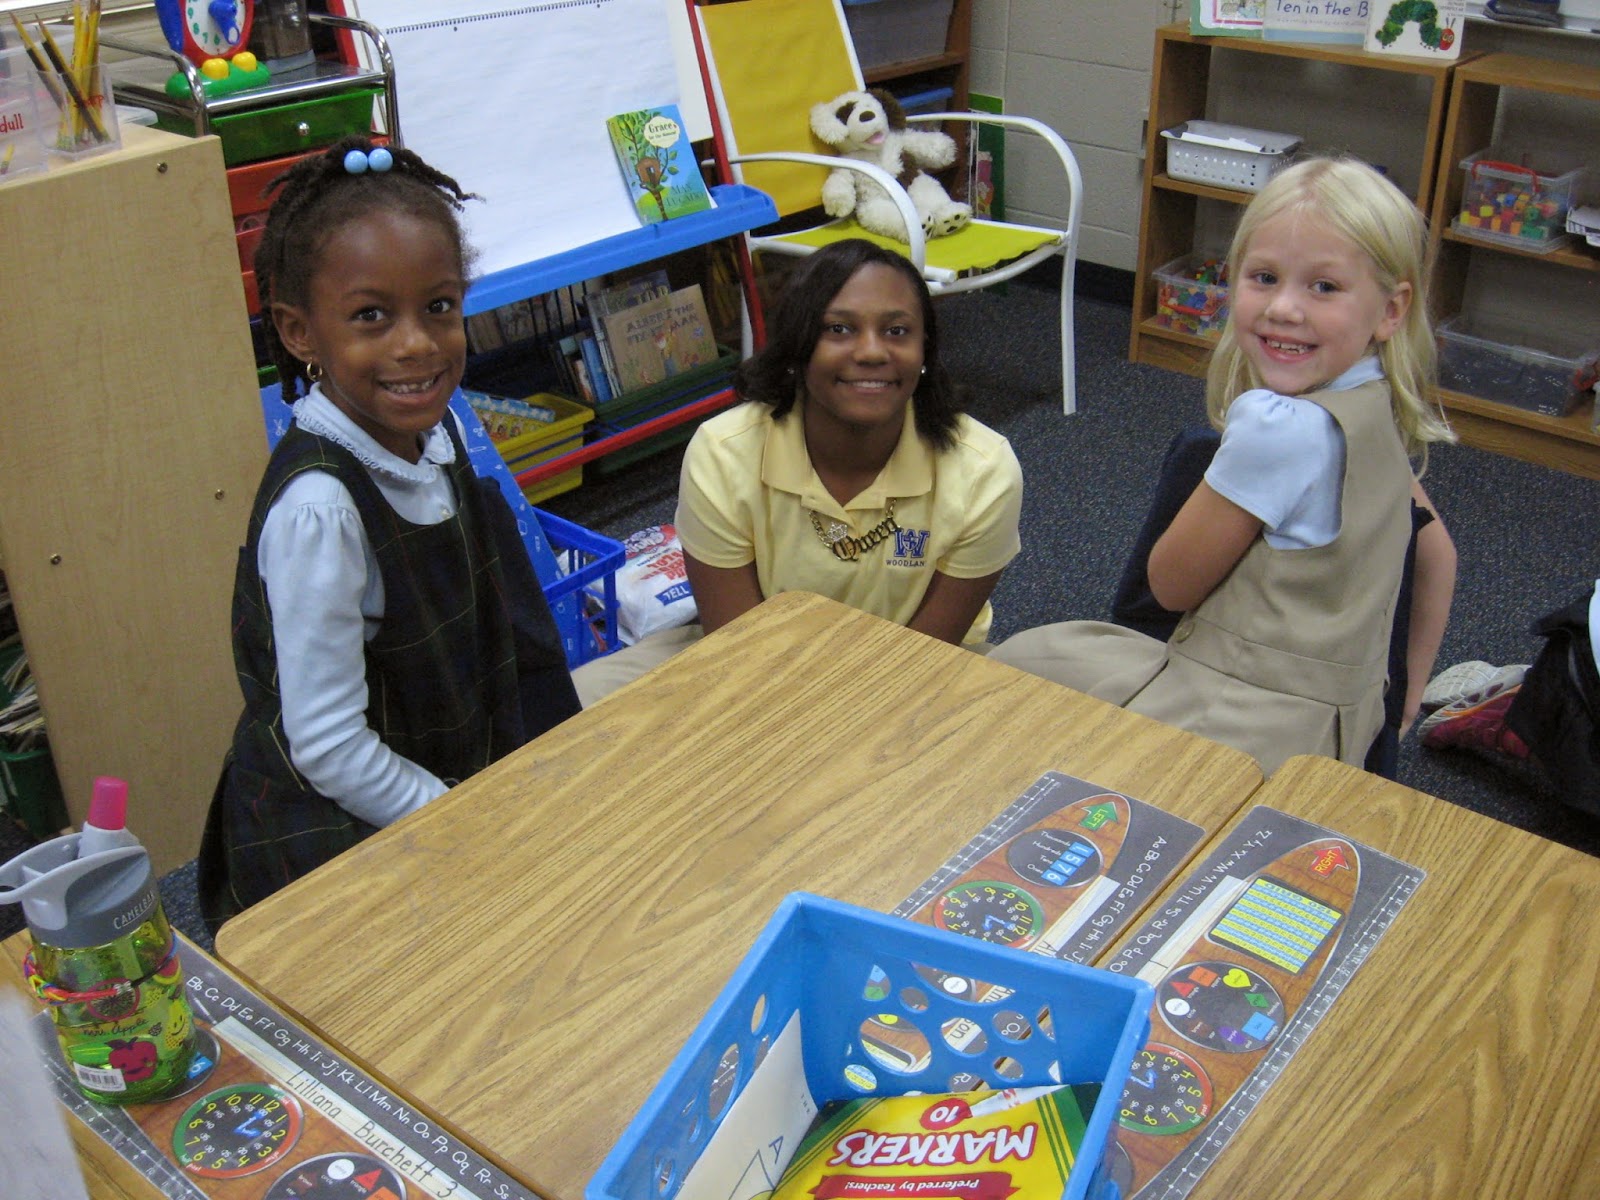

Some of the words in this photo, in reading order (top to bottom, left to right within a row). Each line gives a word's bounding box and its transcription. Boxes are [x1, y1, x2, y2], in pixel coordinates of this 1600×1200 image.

[1305, 1, 1319, 14] in
[1325, 0, 1350, 16] the
[202, 32, 208, 44] 7
[648, 123, 673, 133] Grace
[1087, 808, 1109, 828] LEFT
[1152, 836, 1168, 848] Aa
[1065, 854, 1081, 863] 5
[1144, 850, 1160, 861] Bb
[1314, 850, 1338, 873] RIGHT
[1058, 863, 1072, 873] 7
[1136, 862, 1151, 874] Cc
[1047, 873, 1061, 881] 6
[1127, 874, 1144, 888] Dd
[965, 889, 977, 898] 7
[984, 887, 996, 896] 8
[1118, 887, 1134, 898] Ee
[949, 897, 961, 905] 6
[1015, 901, 1029, 912] 10
[1109, 960, 1128, 973] Oo
[1122, 949, 1144, 959] Pp
[1137, 933, 1162, 945] Qq
[1151, 919, 1168, 930] Rr
[1165, 907, 1182, 918] Ss
[1176, 894, 1194, 905] Tt
[1188, 884, 1207, 896] Uu
[1201, 874, 1217, 884] Vv
[1212, 860, 1235, 874] Ww
[1230, 849, 1248, 860] Xx
[1242, 840, 1263, 848] Yy
[1256, 829, 1273, 839] Zz
[1110, 900, 1125, 914] Ff
[943, 909, 956, 918] 5
[1019, 915, 1033, 924] 11
[1092, 914, 1114, 927] Gg
[947, 923, 961, 931] 4
[1013, 925, 1028, 936] 12
[1086, 928, 1104, 941] Hh
[1078, 942, 1093, 951] Ii
[1141, 1051, 1156, 1061] 2
[1164, 1056, 1179, 1066] 3
[194, 1060, 206, 1074] 6
[1180, 1069, 1195, 1079] 4
[186, 976, 204, 991] Bb
[204, 987, 220, 1002] Cc
[220, 997, 242, 1011] Dd
[238, 1007, 254, 1020] Ee
[254, 1017, 275, 1030] Ff
[274, 1029, 291, 1046] Gg
[292, 1039, 311, 1055] Hh
[310, 1051, 323, 1062] Ii
[322, 1060, 339, 1076] Jj
[337, 1068, 355, 1084] Kk
[354, 1080, 373, 1094] Ll
[368, 1090, 392, 1111] Mm
[392, 1106, 410, 1125] Nn
[413, 1122, 430, 1139] Oo
[432, 1135, 449, 1154] Pp
[451, 1151, 471, 1175] Qq
[474, 1168, 492, 1184] Rr
[494, 1184, 509, 1200] Ss
[1187, 1086, 1202, 1098] 5
[225, 1093, 241, 1106] 10
[249, 1093, 265, 1105] 11
[205, 1102, 217, 1114] 9
[264, 1099, 280, 1113] 12
[1183, 1104, 1196, 1114] 6
[275, 1114, 288, 1123] 1
[929, 1105, 960, 1123] 10
[1121, 1109, 1136, 1117] 9
[1166, 1112, 1180, 1123] 7
[189, 1118, 204, 1129] 8
[1144, 1114, 1158, 1125] 8
[271, 1130, 286, 1140] 2
[286, 1069, 343, 1120] Lilliana
[354, 1120, 438, 1183] Burchett
[437, 1180, 459, 1199] 3
[185, 1136, 200, 1146] 7
[829, 1124, 1036, 1166] MARKERS
[193, 1151, 207, 1161] 6
[258, 1146, 273, 1157] 3
[211, 1158, 227, 1169] 5
[238, 1155, 250, 1168] 4
[844, 1181, 895, 1192] Teachers!
[899, 1181, 916, 1192] by
[917, 1179, 980, 1193] Preferred
